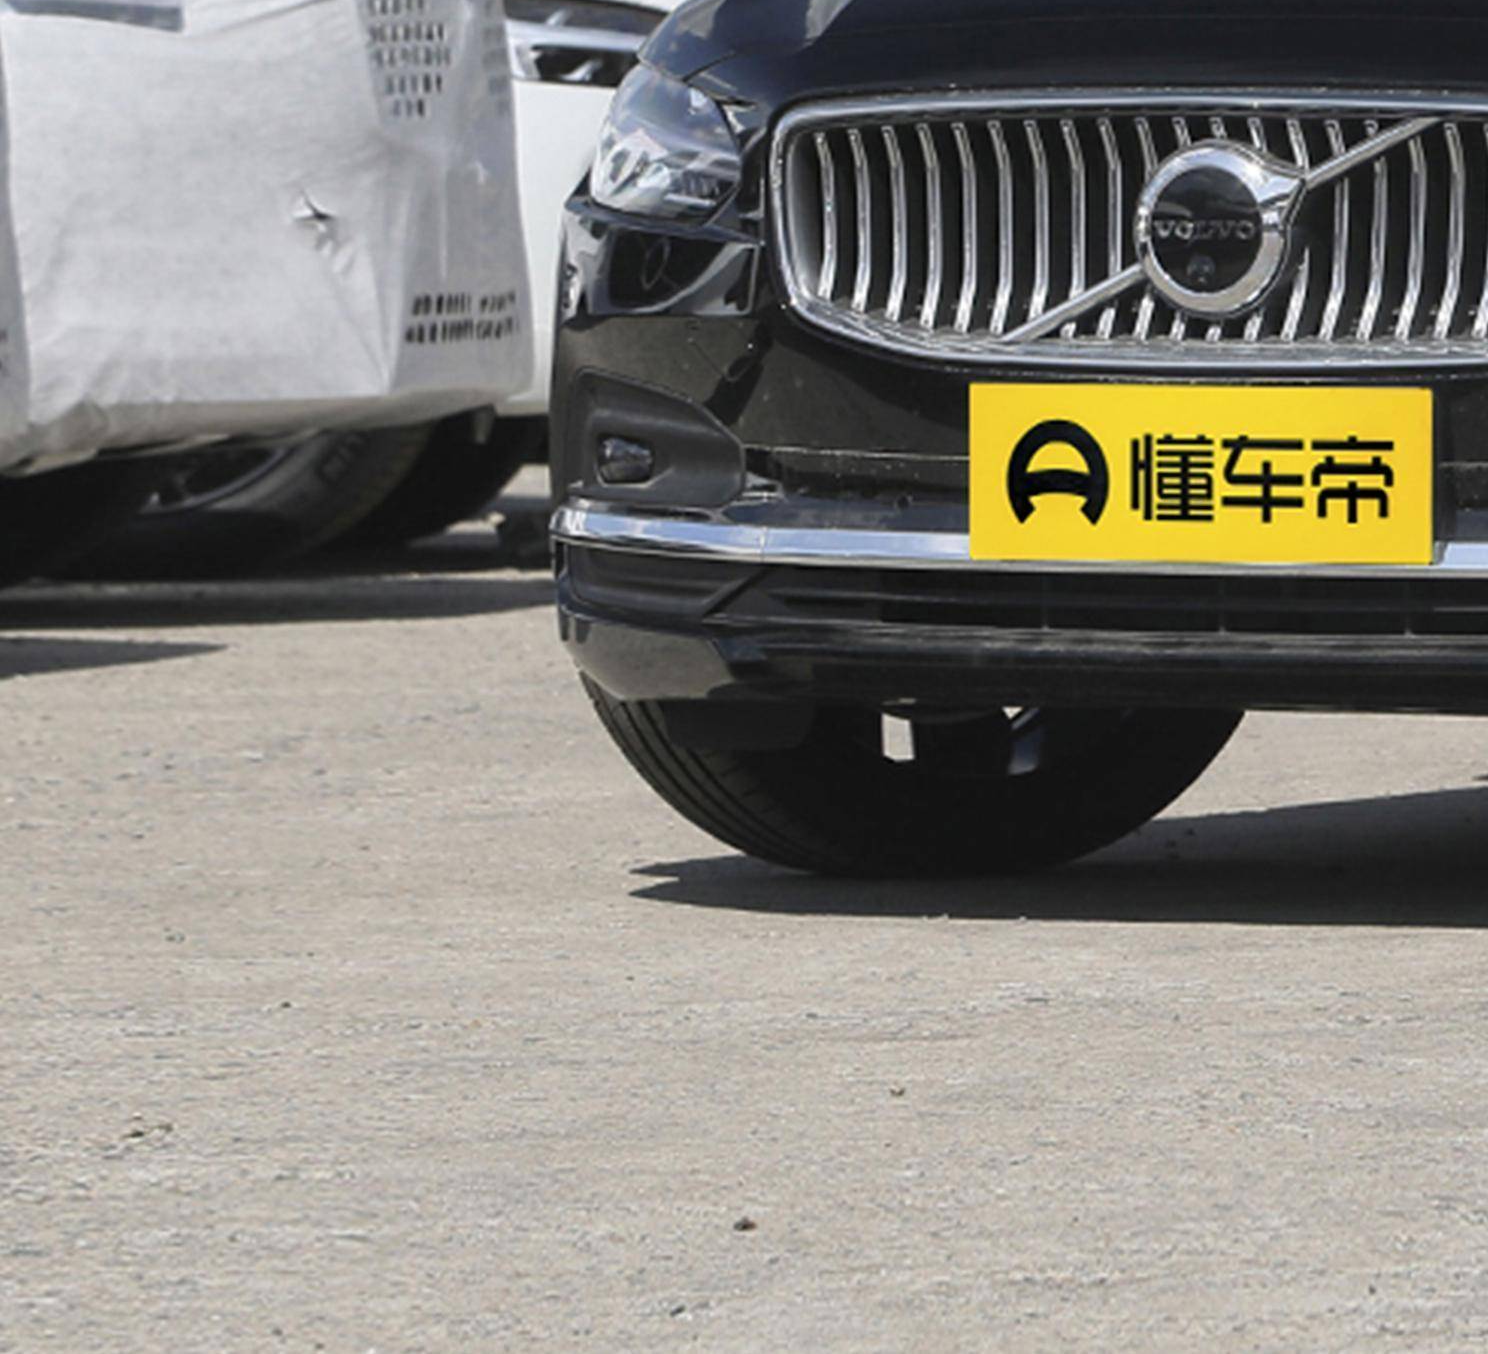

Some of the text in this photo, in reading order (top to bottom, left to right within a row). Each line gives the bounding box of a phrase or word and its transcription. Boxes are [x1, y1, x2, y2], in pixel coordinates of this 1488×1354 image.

[1153, 219, 1256, 240] VOLVO
[1130, 433, 1394, 524] 懂车帝
